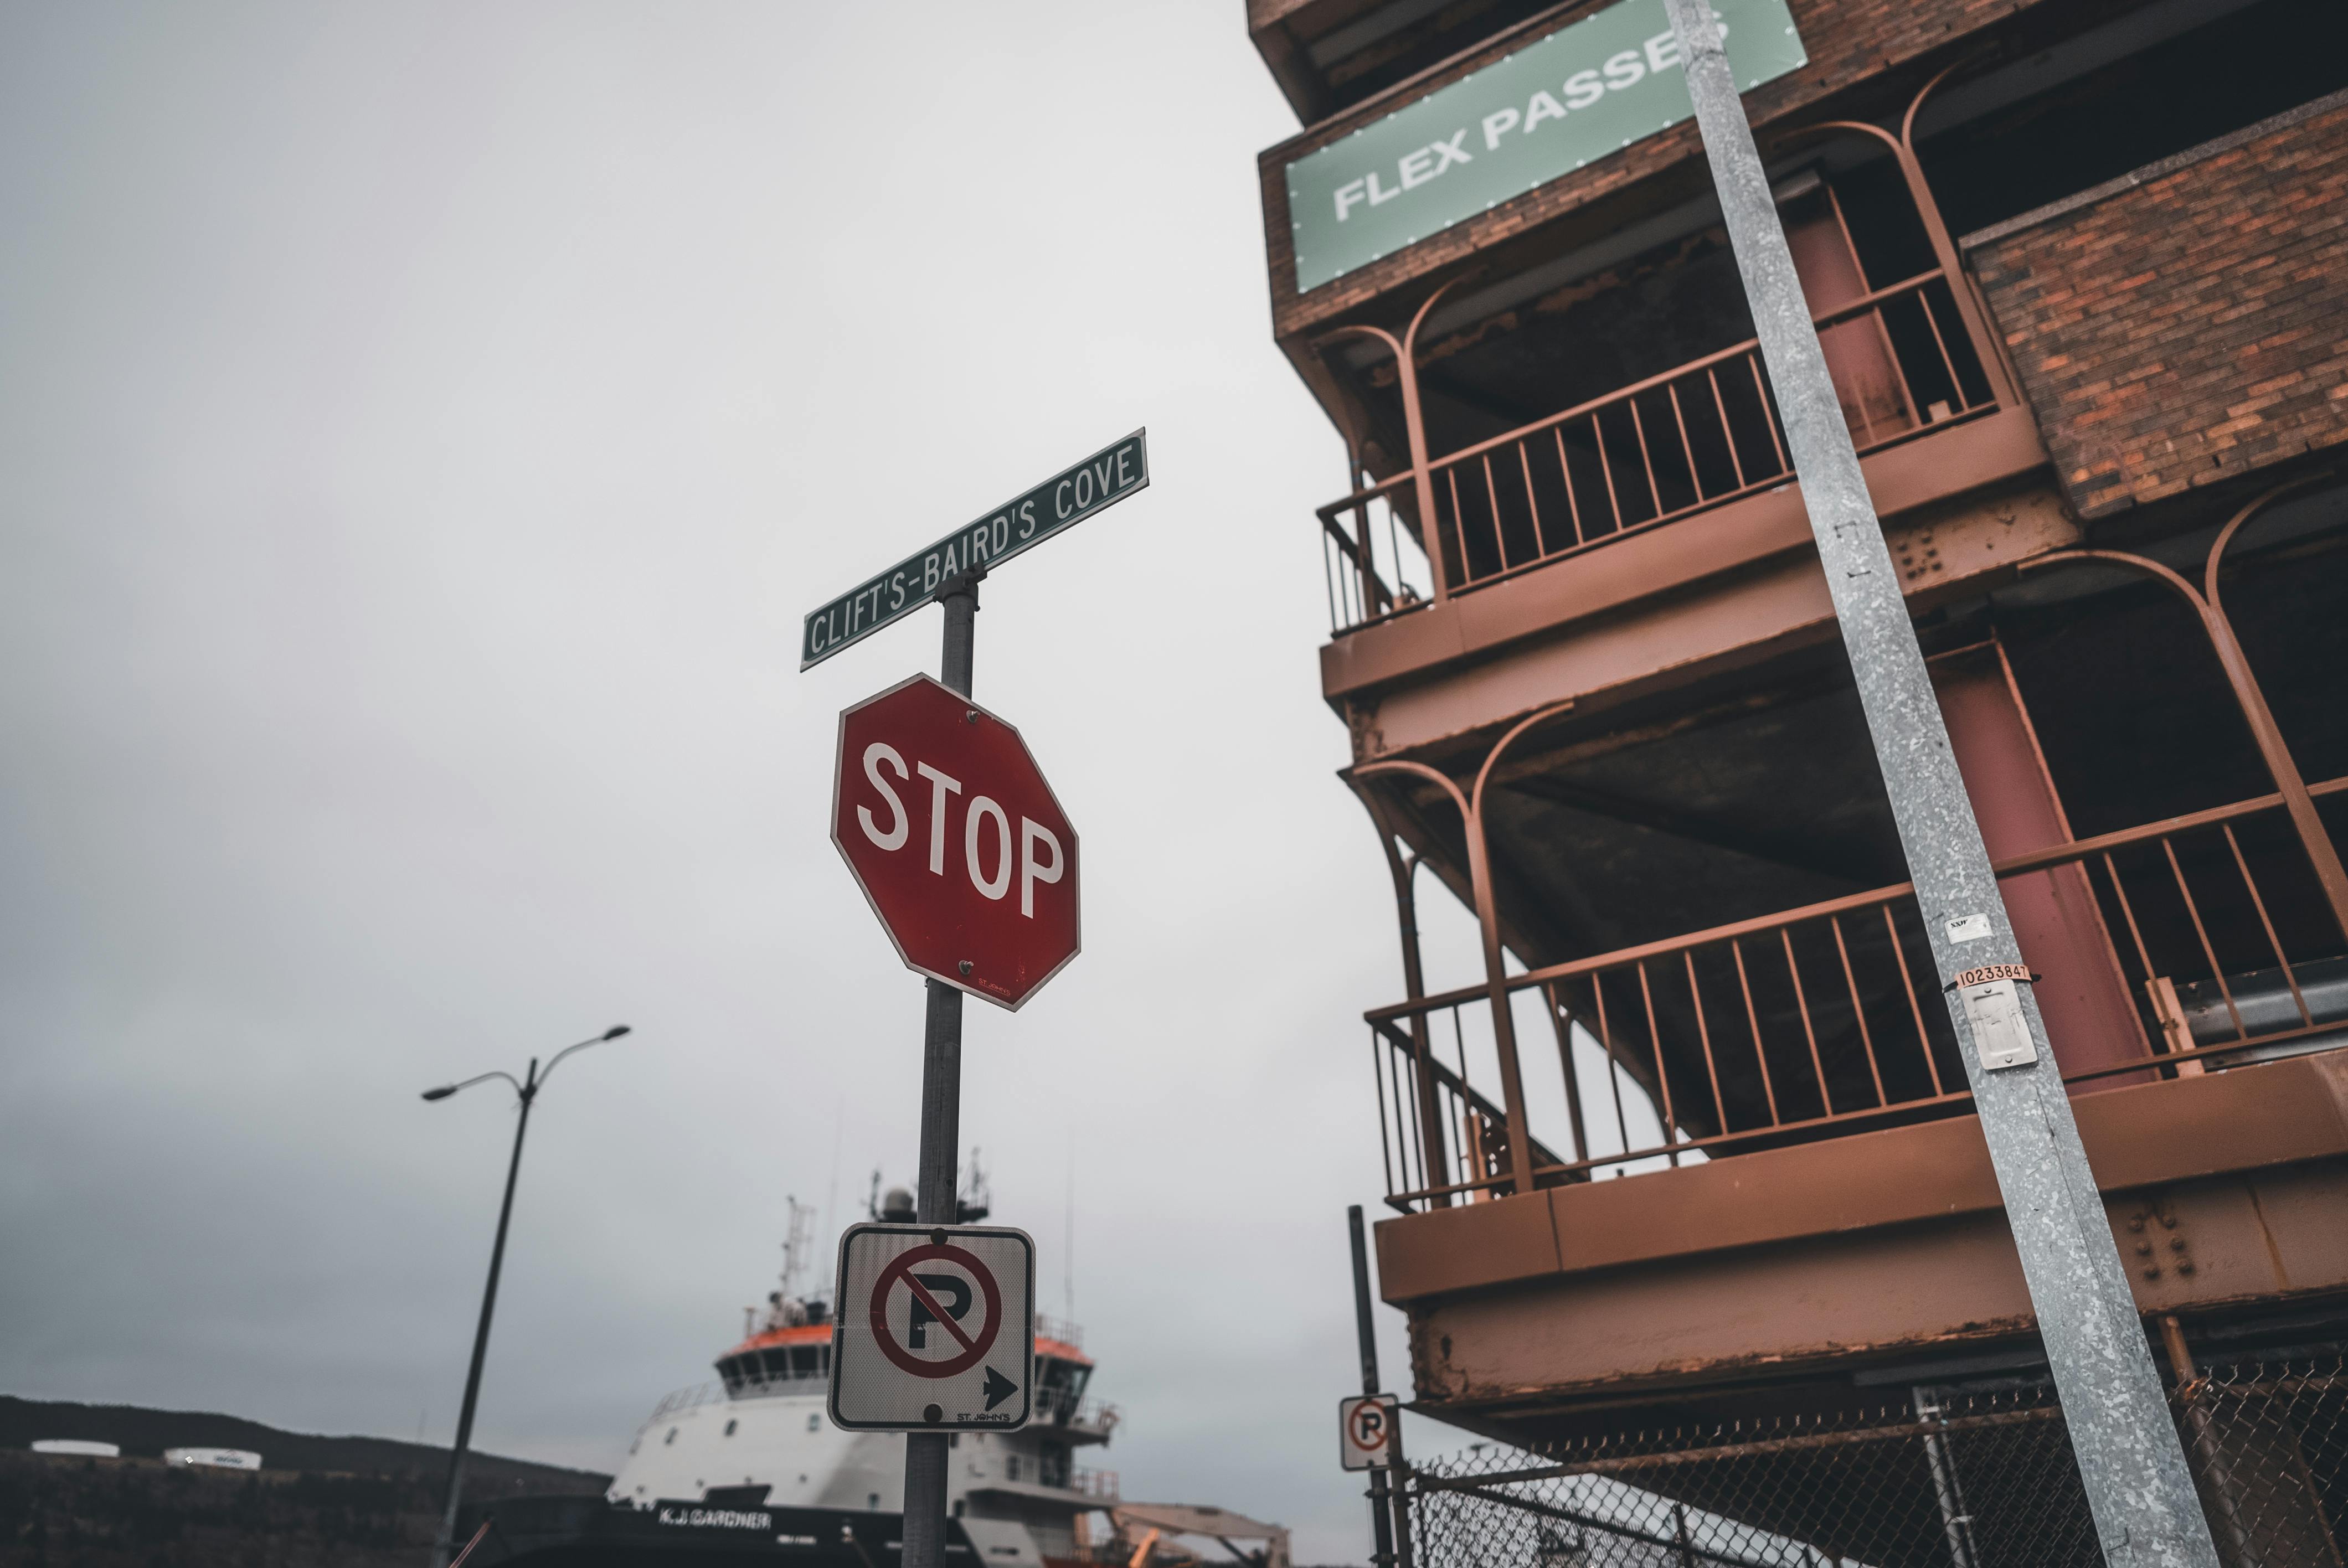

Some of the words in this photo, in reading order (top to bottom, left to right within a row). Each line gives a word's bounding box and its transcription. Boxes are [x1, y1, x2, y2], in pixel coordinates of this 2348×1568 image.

[1333, 128, 1473, 221] FLEX
[1481, 11, 1729, 151] PASSE
[811, 499, 1036, 654] CLIFT'S-BAIRD'S
[1055, 444, 1136, 519] COVE
[857, 742, 1064, 919] STOP
[1960, 966, 2026, 986] 10233847
[908, 1273, 972, 1349] P
[957, 1413, 971, 1421] ST.
[974, 1413, 1011, 1421] JOHN'S
[1361, 1412, 1382, 1440] P
